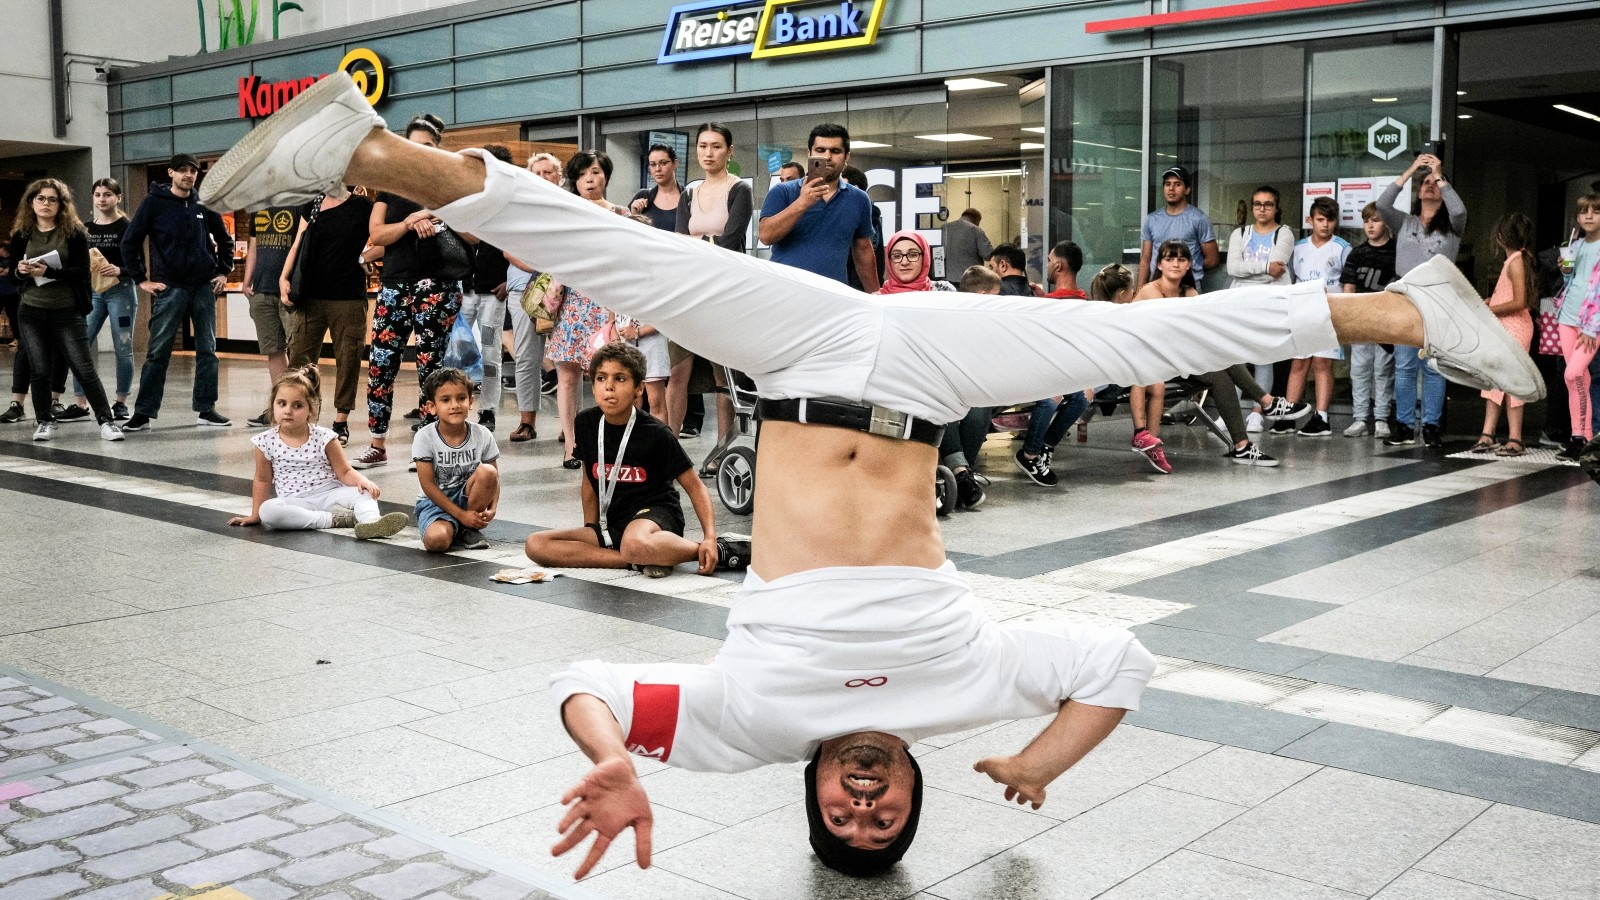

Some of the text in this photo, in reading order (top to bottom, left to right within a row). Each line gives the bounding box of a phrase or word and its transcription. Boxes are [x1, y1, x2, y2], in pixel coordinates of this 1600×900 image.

[675, 2, 860, 50] Reise Bank
[238, 73, 331, 119] Kam
[1376, 133, 1399, 144] VRR
[1356, 266, 1390, 291] FIL
